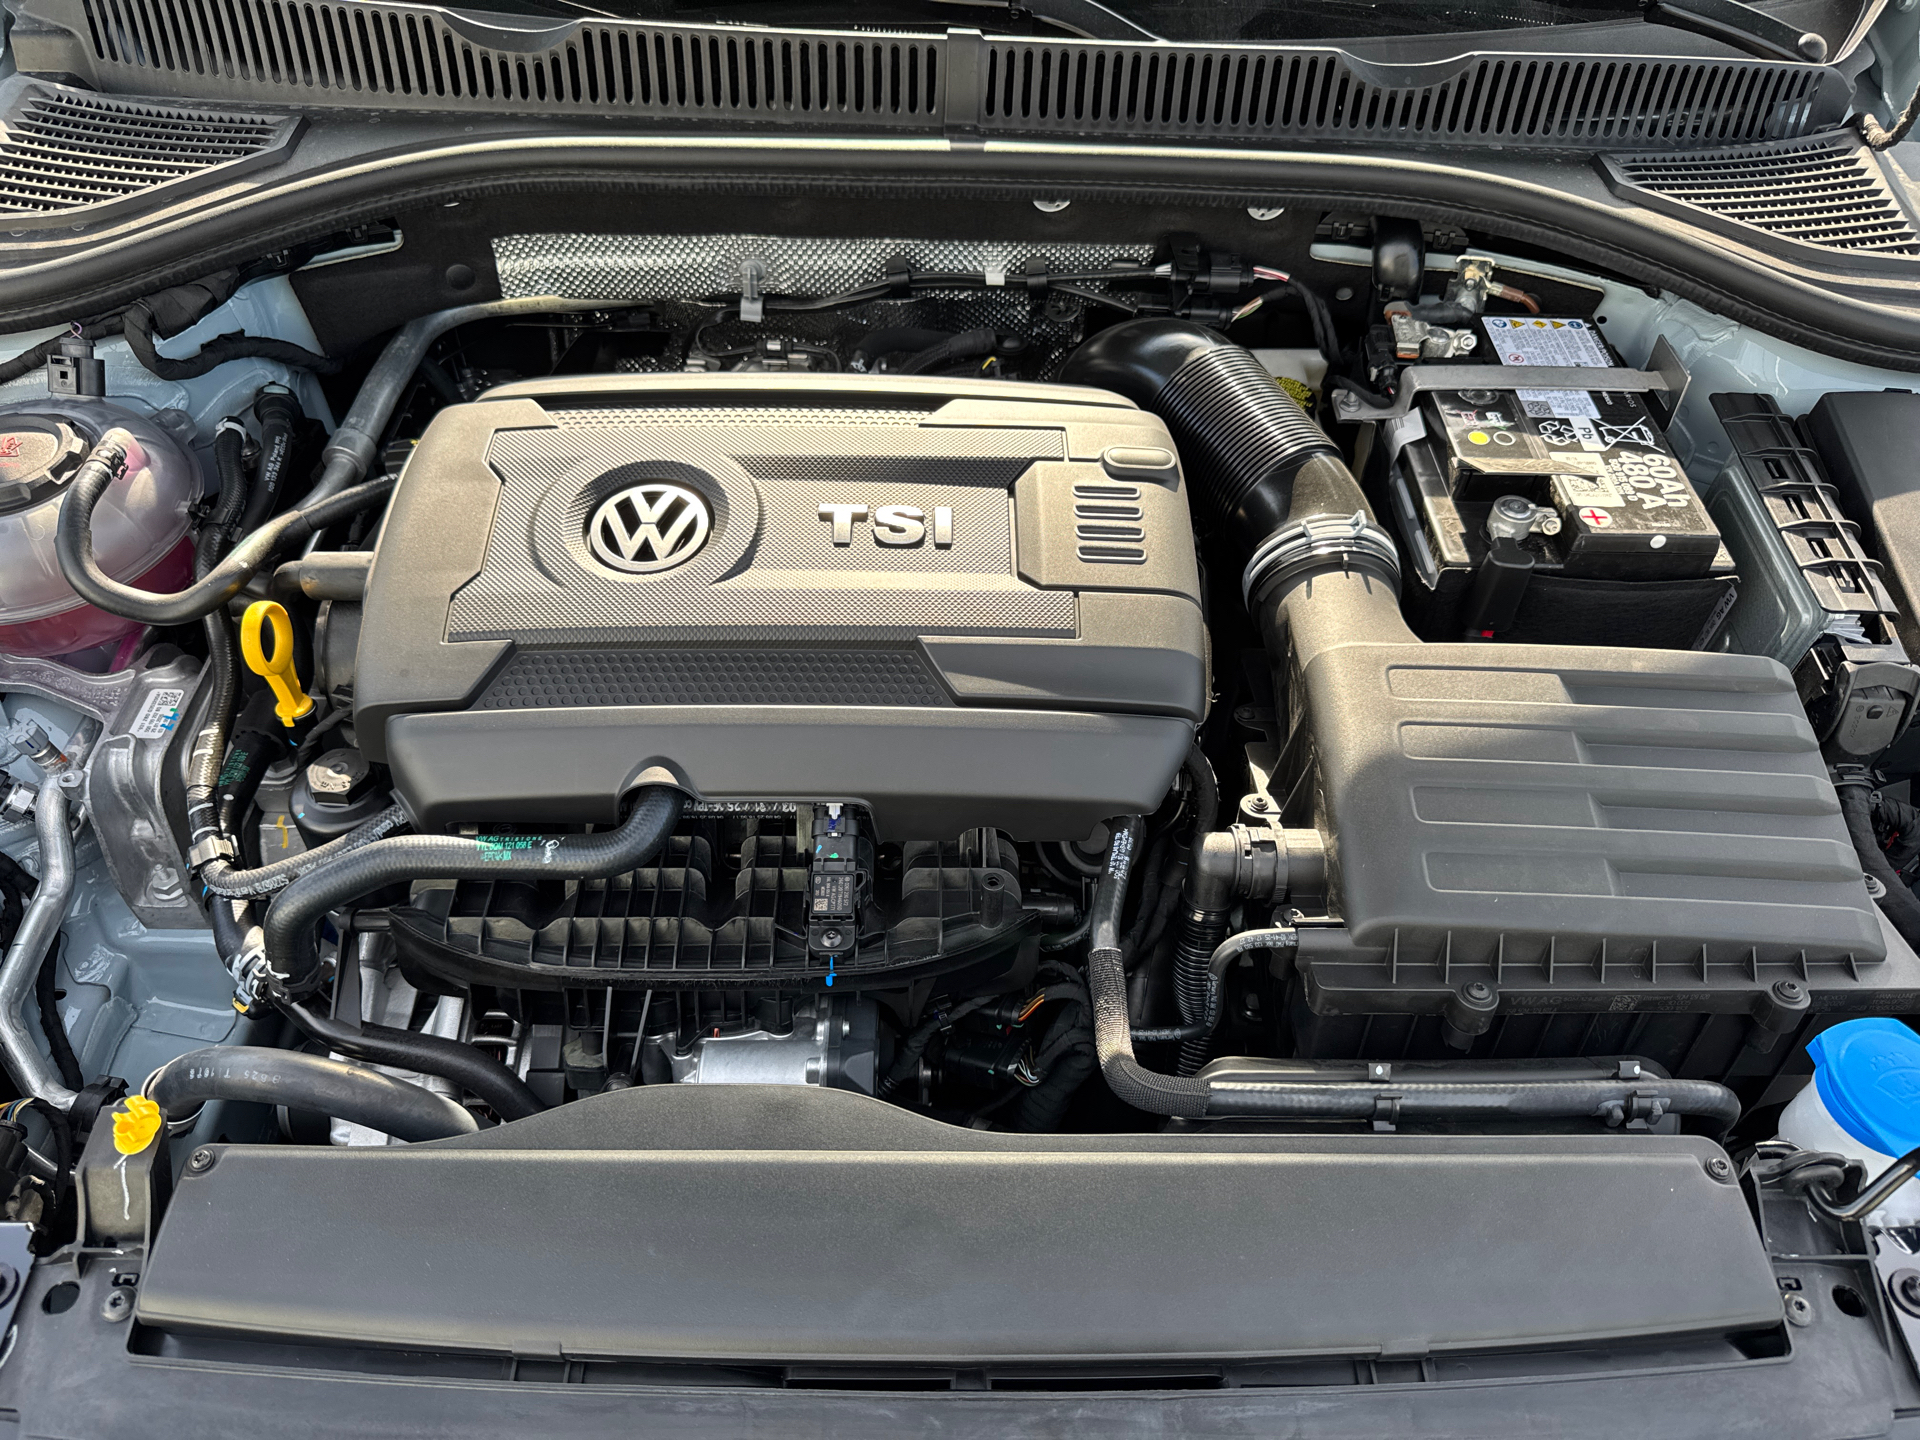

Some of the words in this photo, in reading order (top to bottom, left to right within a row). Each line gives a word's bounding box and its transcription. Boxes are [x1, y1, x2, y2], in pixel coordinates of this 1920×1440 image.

[1578, 427, 1594, 440] Pb
[1618, 451, 1656, 488] 480
[1643, 453, 1691, 507] 60Ah
[1636, 492, 1667, 509] A
[818, 501, 955, 549] TSI
[1510, 996, 1538, 1005] VW
[1539, 996, 1563, 1005] AG
